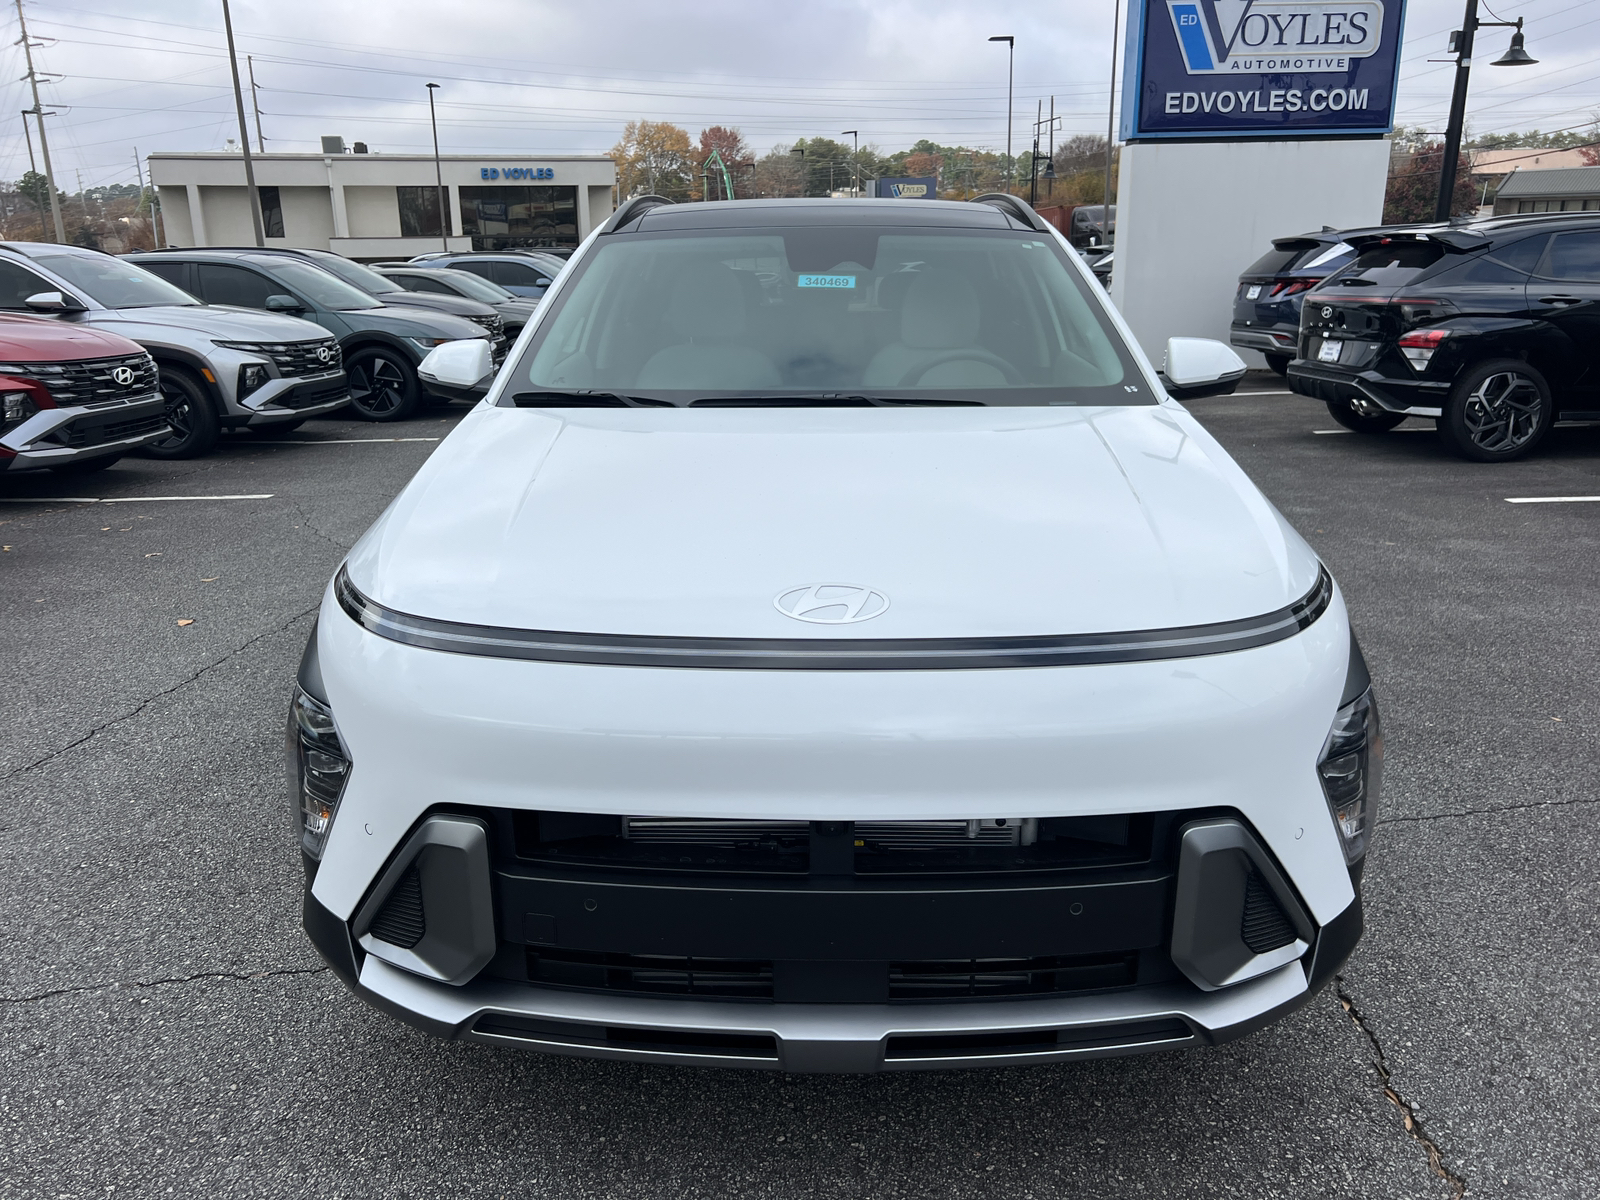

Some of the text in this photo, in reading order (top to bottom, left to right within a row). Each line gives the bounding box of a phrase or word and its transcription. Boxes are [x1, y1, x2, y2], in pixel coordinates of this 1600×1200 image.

[1180, 0, 1369, 63] ED VOYLES
[1231, 58, 1346, 70] AUTOMOTIVE
[1165, 88, 1369, 114] EDVOYLES.COM
[480, 167, 555, 179] ED VOYLES
[805, 277, 849, 287] 340469
